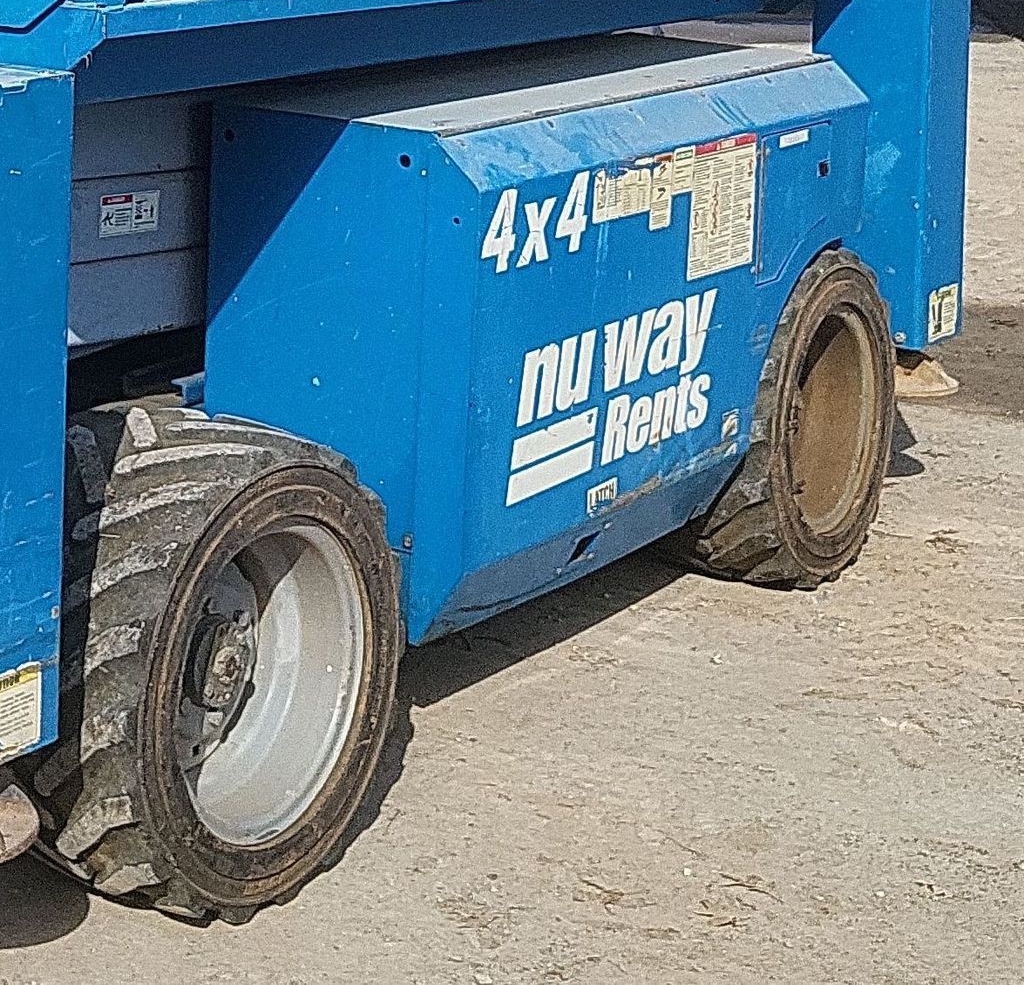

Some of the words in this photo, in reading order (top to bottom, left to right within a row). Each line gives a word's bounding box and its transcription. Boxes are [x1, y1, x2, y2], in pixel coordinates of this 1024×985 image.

[481, 171, 590, 273] 4x4
[517, 329, 597, 427] nu
[604, 288, 718, 392] way
[601, 374, 711, 466] Rents
